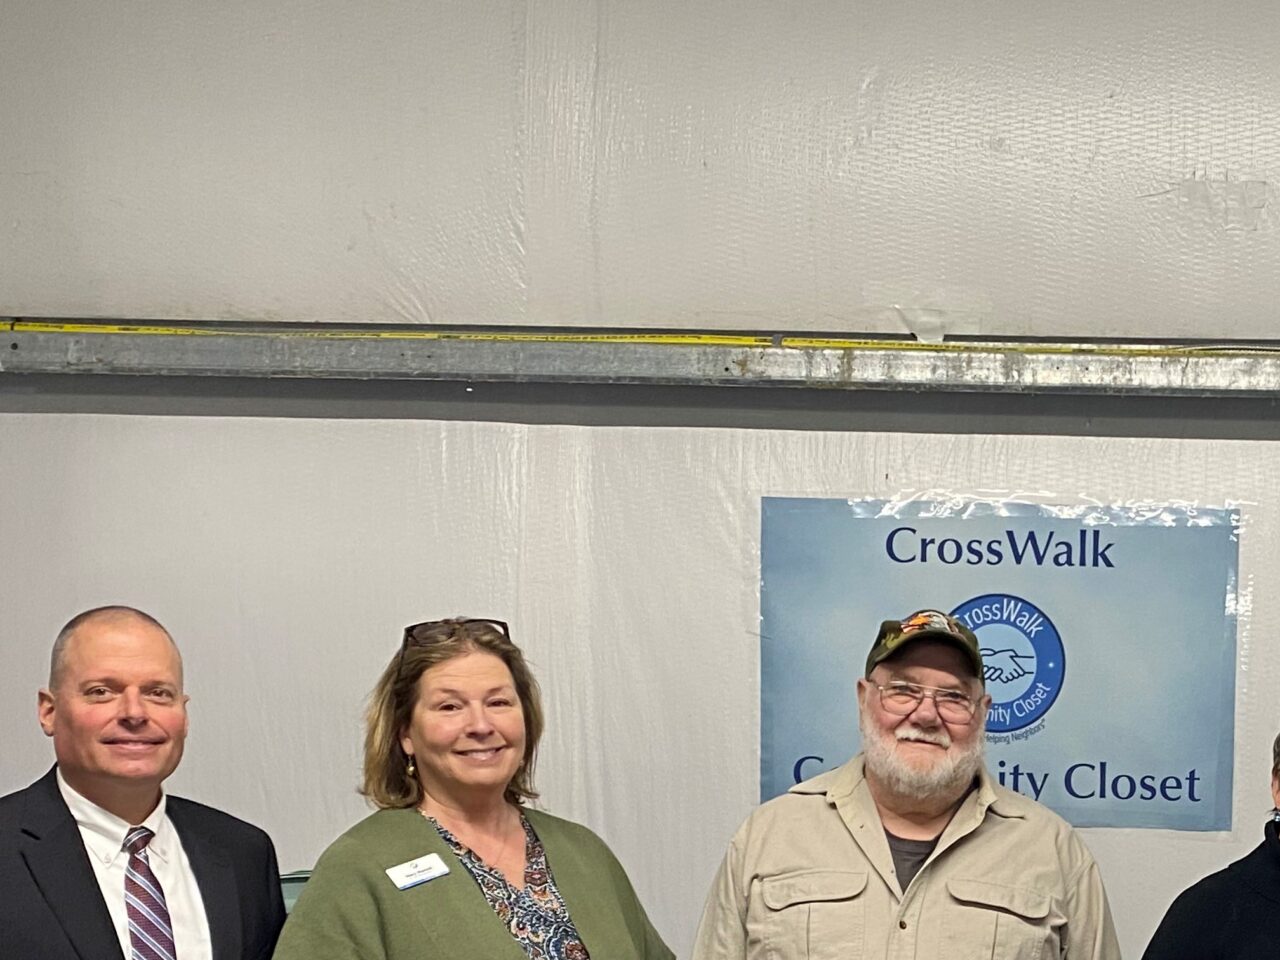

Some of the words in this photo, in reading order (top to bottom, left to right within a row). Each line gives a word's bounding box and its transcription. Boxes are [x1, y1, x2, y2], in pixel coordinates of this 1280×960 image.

[885, 526, 1115, 568] CrossWalk
[952, 598, 1044, 638] rossWalk
[1013, 682, 1051, 717] Closet
[1064, 761, 1202, 803] Closet
